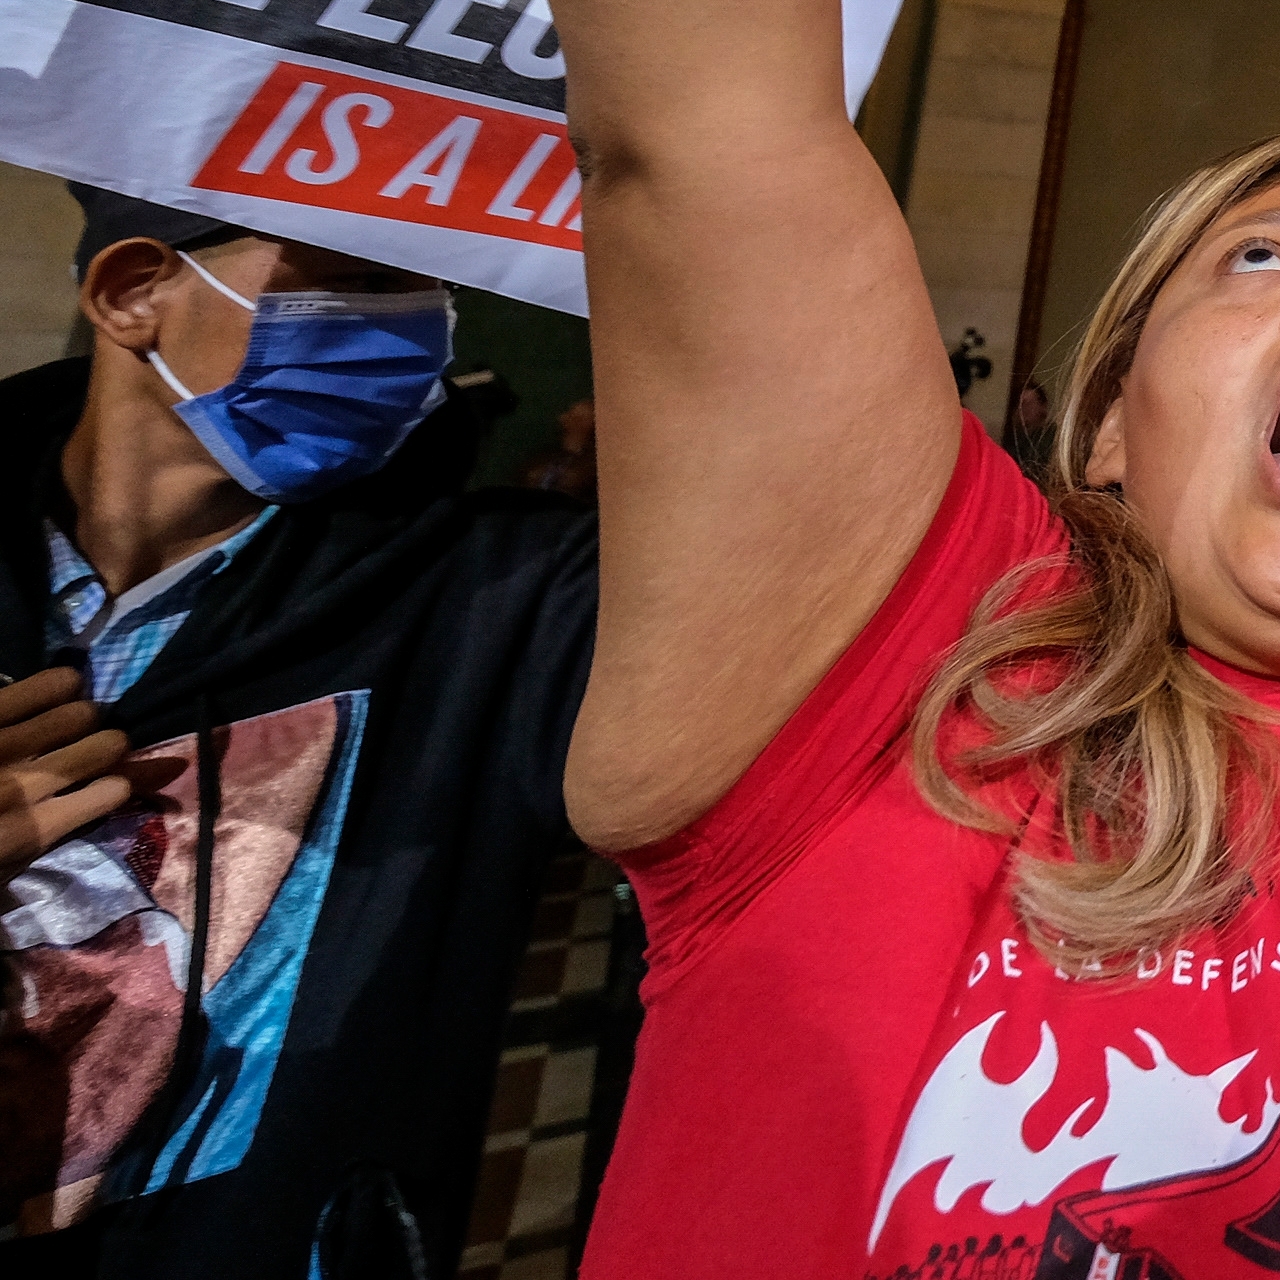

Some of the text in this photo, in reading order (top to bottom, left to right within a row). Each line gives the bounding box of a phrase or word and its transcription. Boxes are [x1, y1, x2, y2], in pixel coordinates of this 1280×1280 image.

[239, 81, 394, 186] IS
[377, 115, 482, 208] A
[966, 937, 1022, 988] DE
